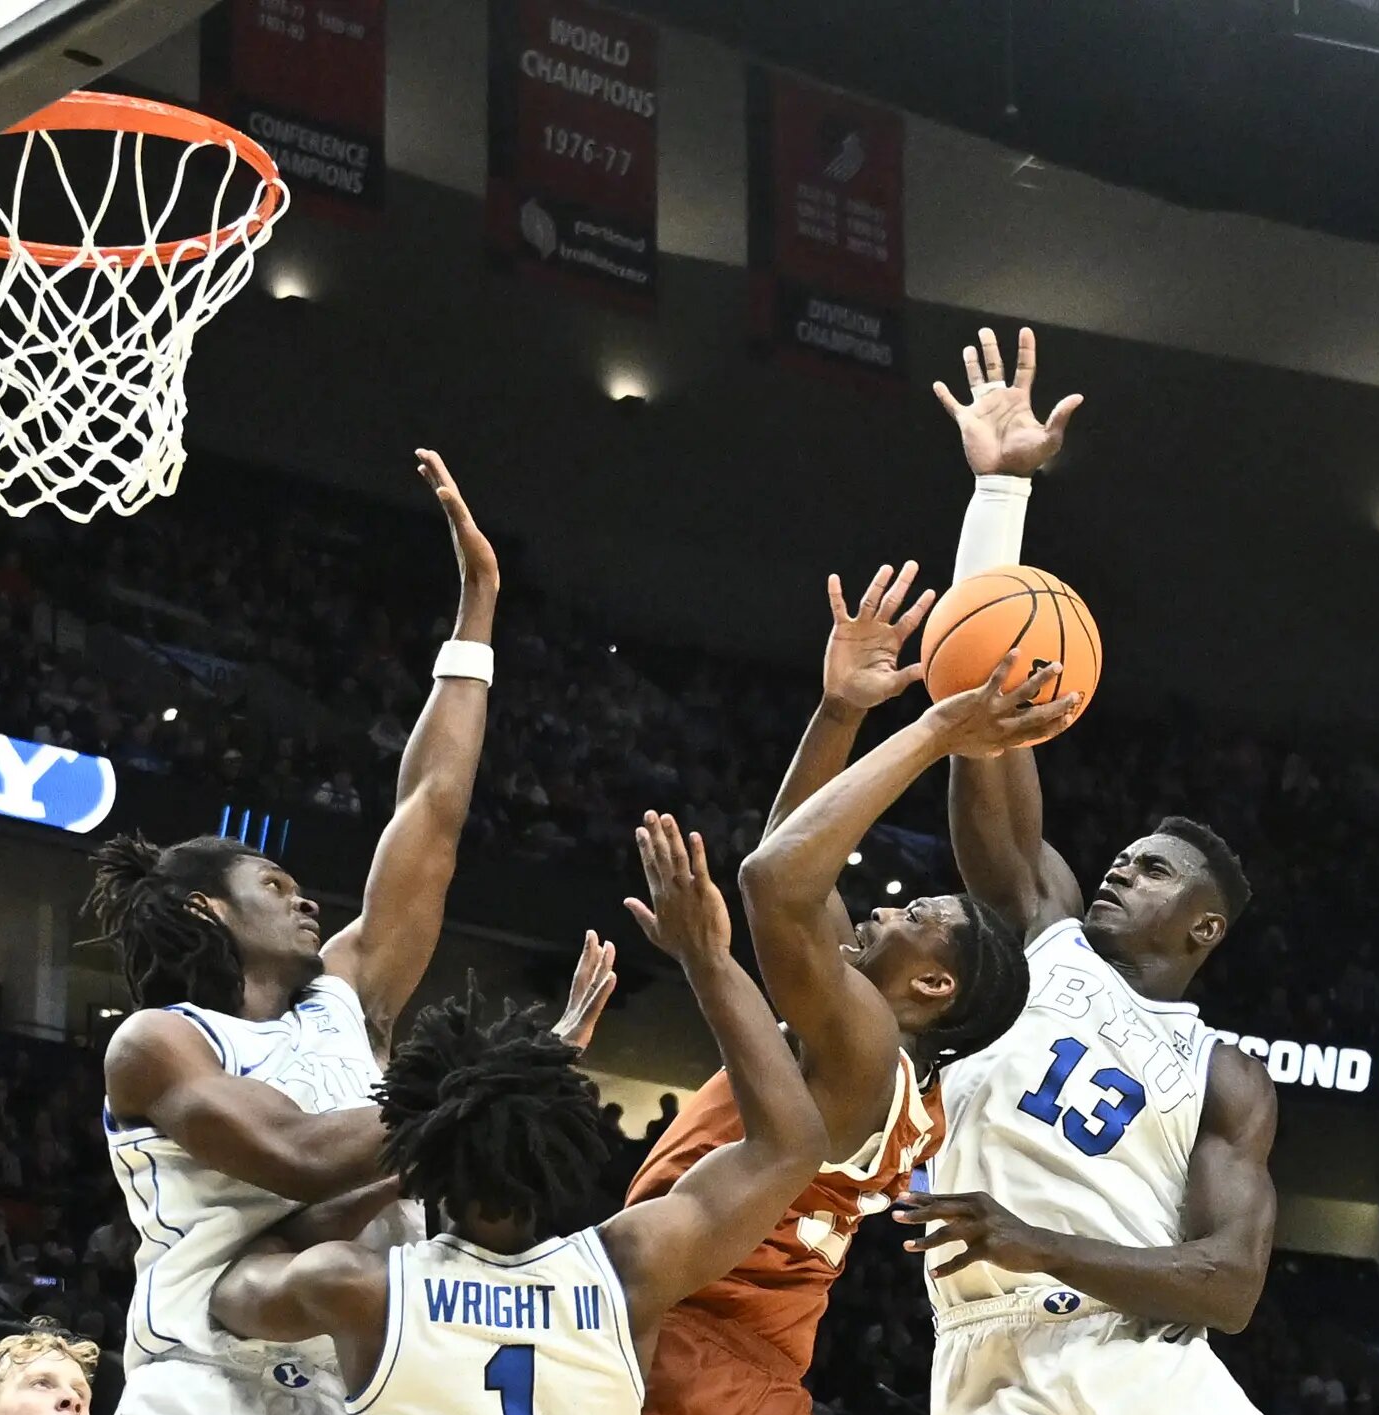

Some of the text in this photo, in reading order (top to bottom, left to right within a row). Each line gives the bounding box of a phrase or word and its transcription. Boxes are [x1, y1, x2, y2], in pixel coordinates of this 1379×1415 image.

[549, 16, 630, 68] WORLD
[520, 49, 656, 119] CHAMPIONS
[248, 111, 370, 170] CONFERENCE
[543, 124, 633, 177] 1976-77
[1028, 963, 1197, 1115] BYU
[1017, 1036, 1147, 1157] 13
[424, 1277, 601, 1331] WRIGHT III
